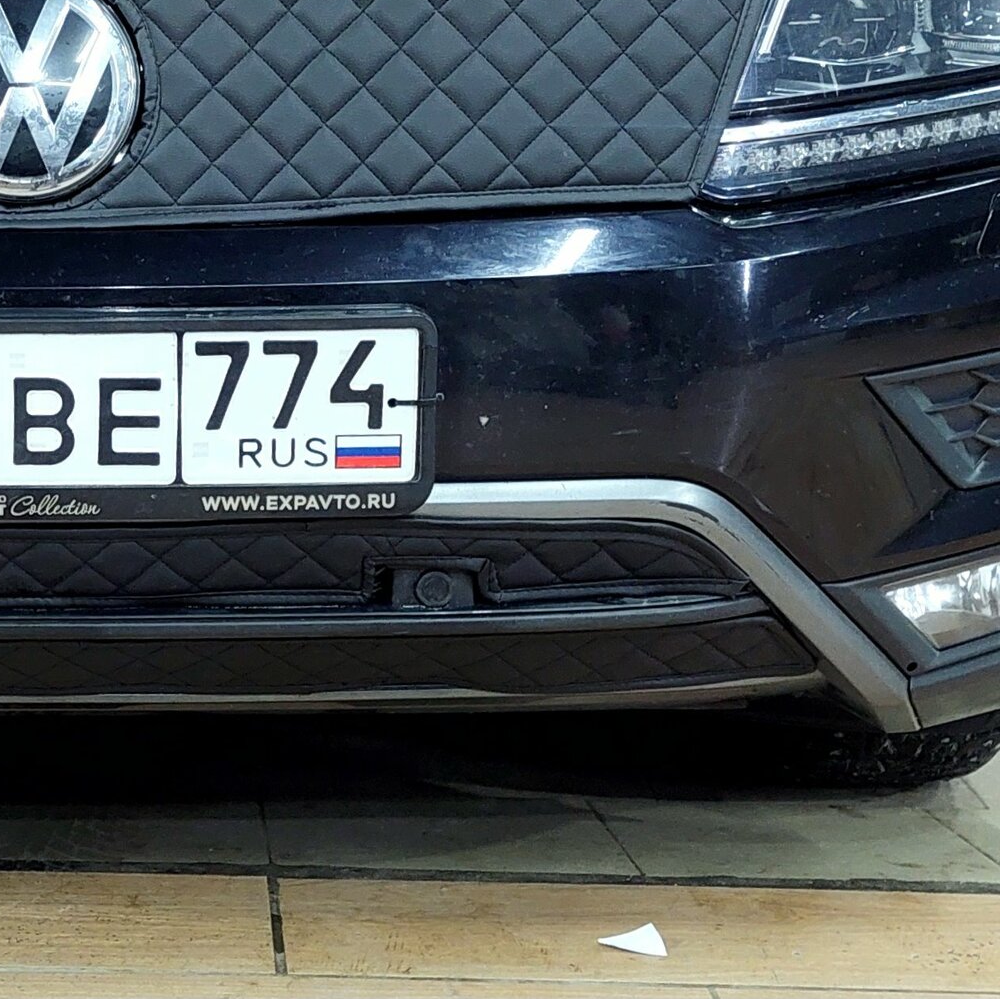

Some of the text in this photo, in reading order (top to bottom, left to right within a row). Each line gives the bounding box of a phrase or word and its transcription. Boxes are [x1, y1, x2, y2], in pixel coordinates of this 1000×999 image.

[195, 340, 384, 430] 774
[238, 437, 328, 469] RUS
[10, 494, 101, 517] Collection
[201, 492, 396, 512] WWW.EXPAVTO.RU
